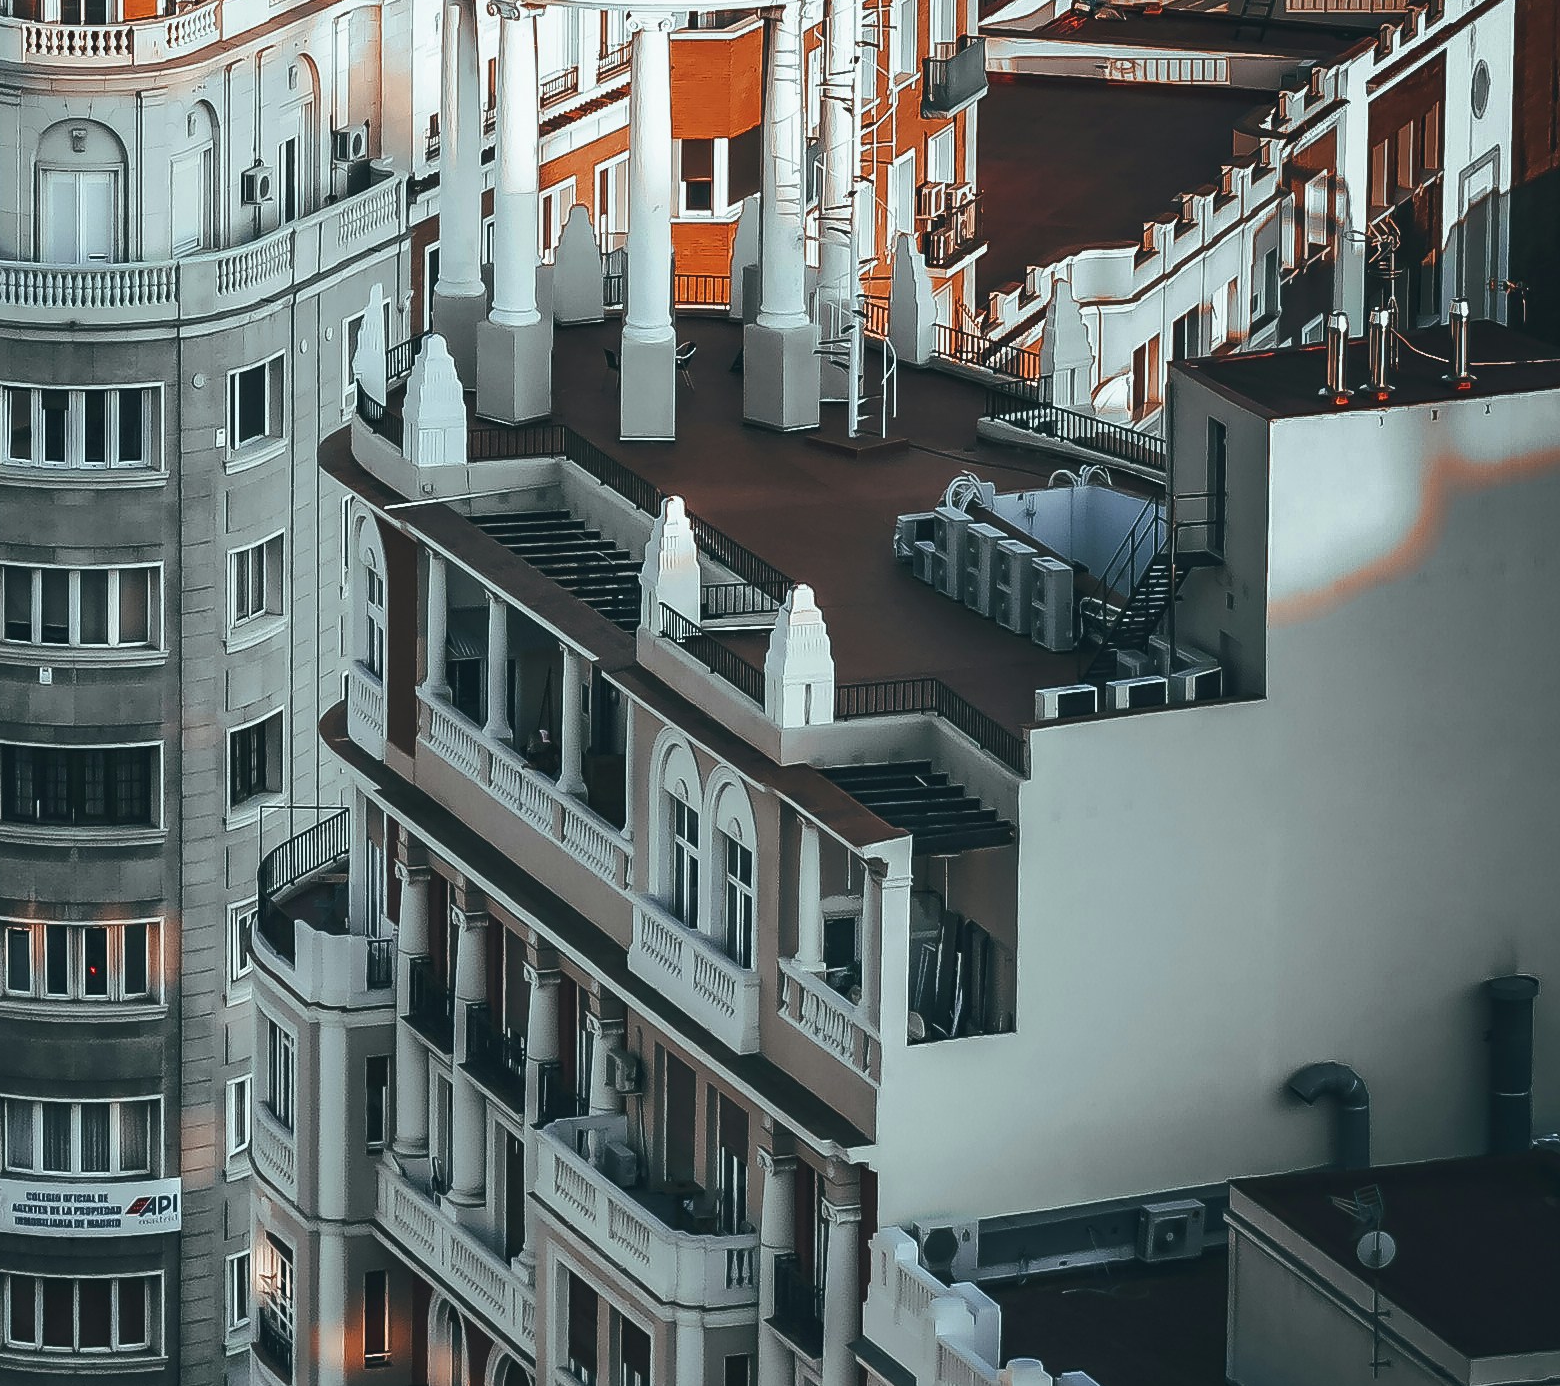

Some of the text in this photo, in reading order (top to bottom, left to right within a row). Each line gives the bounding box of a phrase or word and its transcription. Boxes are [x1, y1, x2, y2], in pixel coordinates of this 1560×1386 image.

[25, 1192, 61, 1203] COLEGIO
[97, 1193, 109, 1204] DE
[49, 1205, 61, 1215] DE
[61, 1206, 73, 1215] LA
[139, 1193, 178, 1218] API
[74, 1219, 86, 1229] DE
[86, 1219, 122, 1229] MADRID
